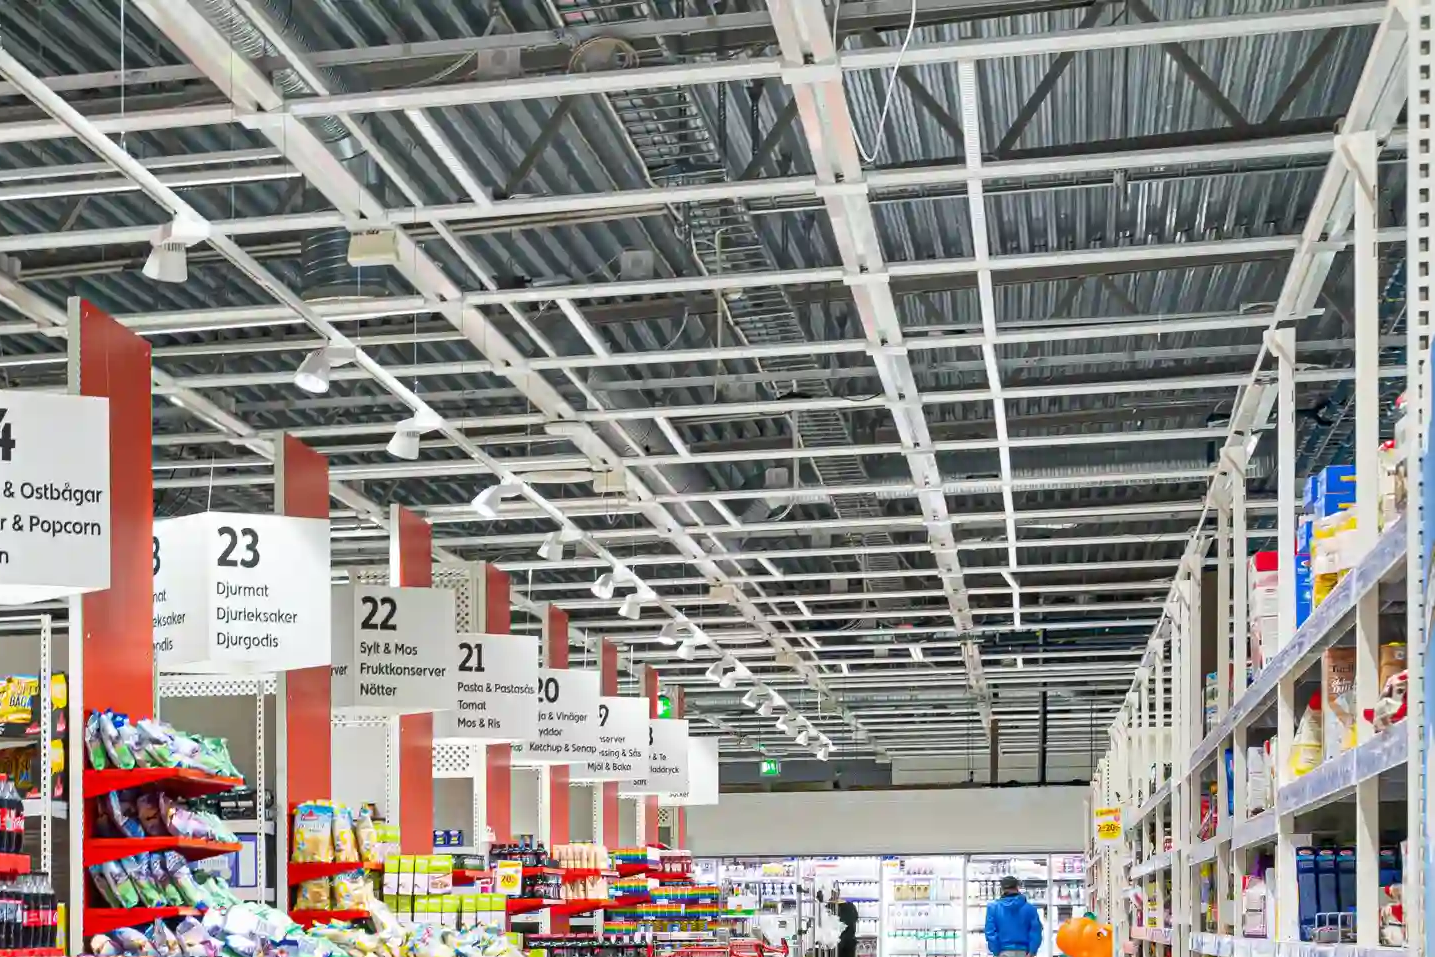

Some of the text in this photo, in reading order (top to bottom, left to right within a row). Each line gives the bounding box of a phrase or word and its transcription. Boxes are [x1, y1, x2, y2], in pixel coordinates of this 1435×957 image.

[3, 481, 15, 499] &
[20, 481, 103, 507] Ostbågar
[12, 514, 24, 532] &
[29, 515, 101, 537] Popcorn
[217, 525, 260, 569] 23
[216, 581, 269, 599] Djurmat
[153, 611, 186, 628] eksaker
[216, 606, 298, 624] Djurleksaker
[361, 595, 397, 631] 22
[216, 631, 279, 650] Djurgodis
[360, 641, 418, 657] Sylt & Mos
[458, 642, 485, 673] 21
[360, 663, 446, 677] Fruktkonserver
[360, 683, 398, 697] Nötter
[457, 681, 484, 693] Pasta
[485, 682, 493, 694] &
[458, 700, 487, 711] Tomat
[457, 718, 501, 729] Mos & Ris
[556, 711, 588, 723] Vinäger
[599, 704, 610, 727] 9
[538, 728, 563, 737] yddor
[529, 742, 562, 753] Ketchup
[564, 744, 570, 752] &
[571, 744, 597, 754] Senap
[599, 749, 620, 759] ssing
[649, 765, 680, 775] laddryck
